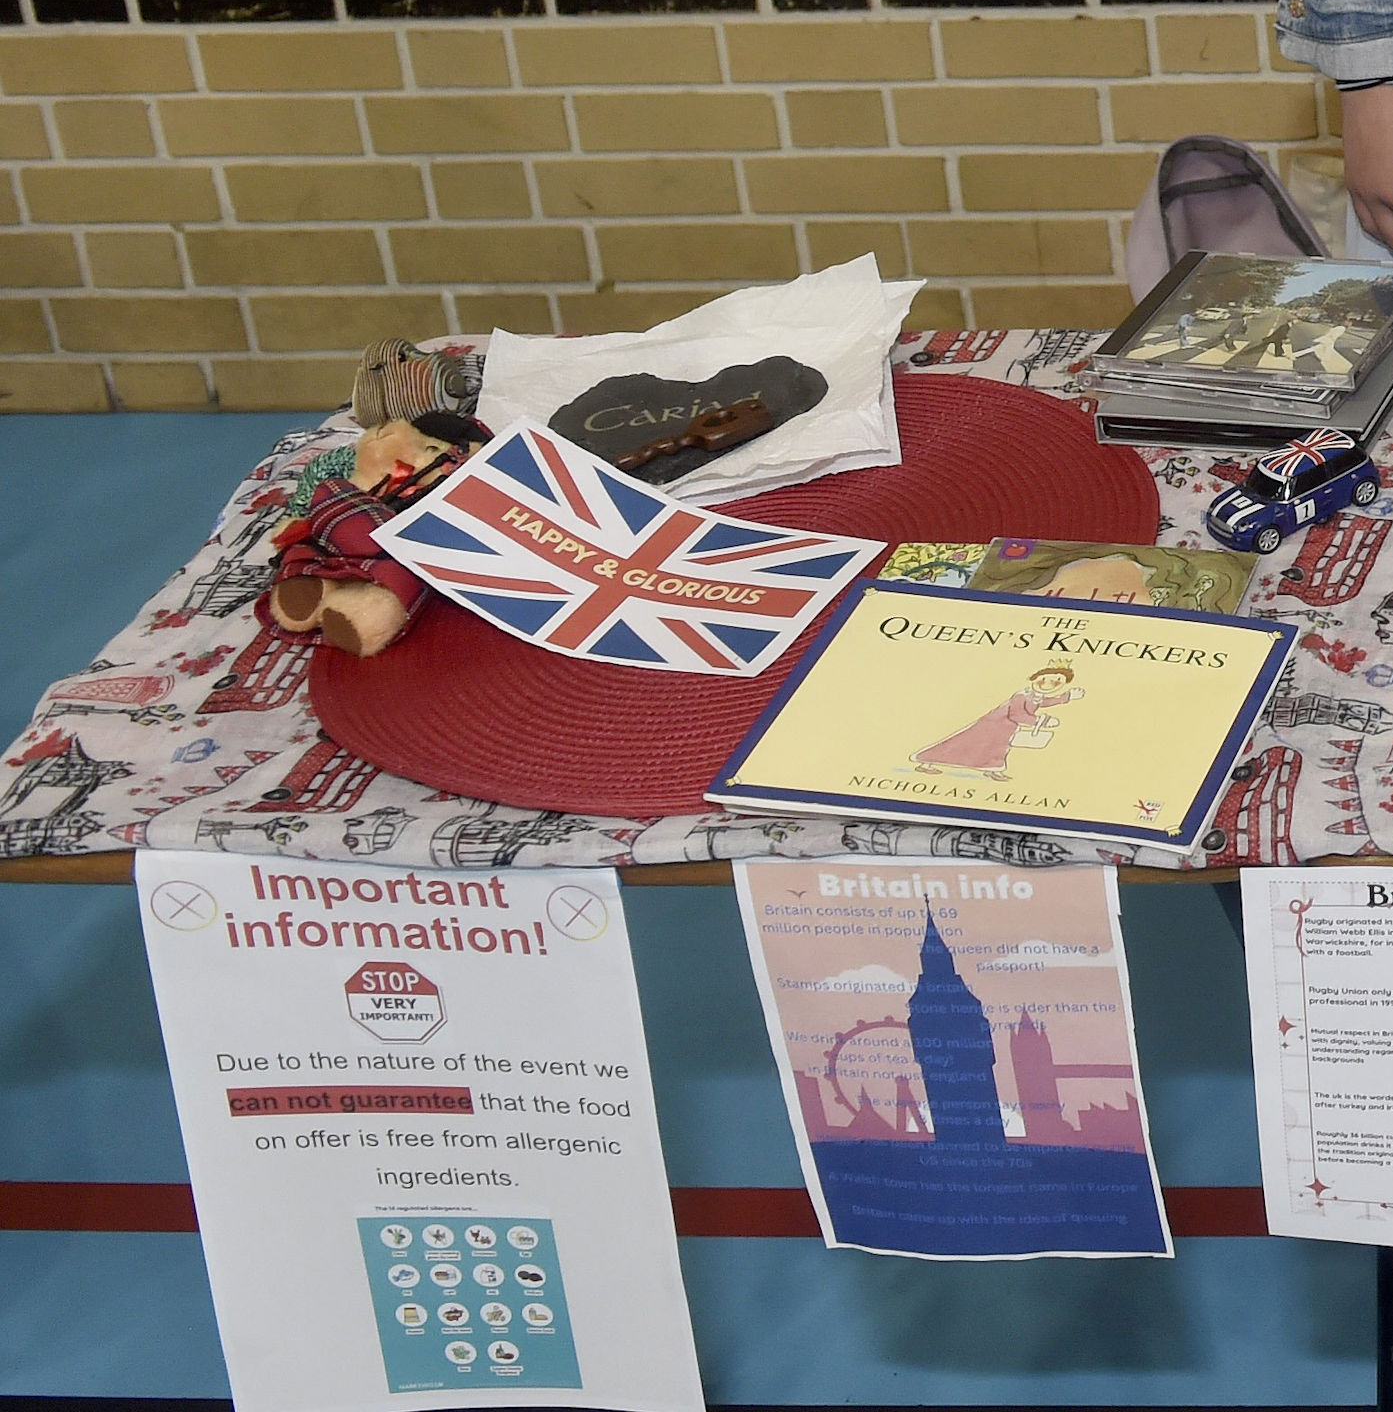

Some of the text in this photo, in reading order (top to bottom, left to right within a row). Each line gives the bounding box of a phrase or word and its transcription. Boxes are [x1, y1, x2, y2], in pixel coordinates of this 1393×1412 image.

[500, 503, 765, 608] HAPPY & GLORIOUS
[1041, 616, 1090, 631] THE
[879, 616, 1228, 669] QUEEN'S KNICKERS
[848, 775, 1070, 809] NICHOLAS ALLAN
[250, 864, 510, 910] Important
[818, 872, 1034, 899] Britain info
[224, 911, 548, 956] information!
[1304, 918, 1333, 927] Rugby
[1336, 919, 1382, 927] originated
[361, 970, 420, 993] STOP
[777, 978, 906, 994] Stamps originated
[359, 1012, 434, 1022] IMPORTANT!
[370, 997, 417, 1010] VERY
[216, 1051, 629, 1080] Due to the nature of the event we
[230, 1090, 631, 1118] can not guarantee that the food
[255, 1128, 622, 1157] on offer is free from allergenic
[376, 1167, 519, 1190] ingredients.
